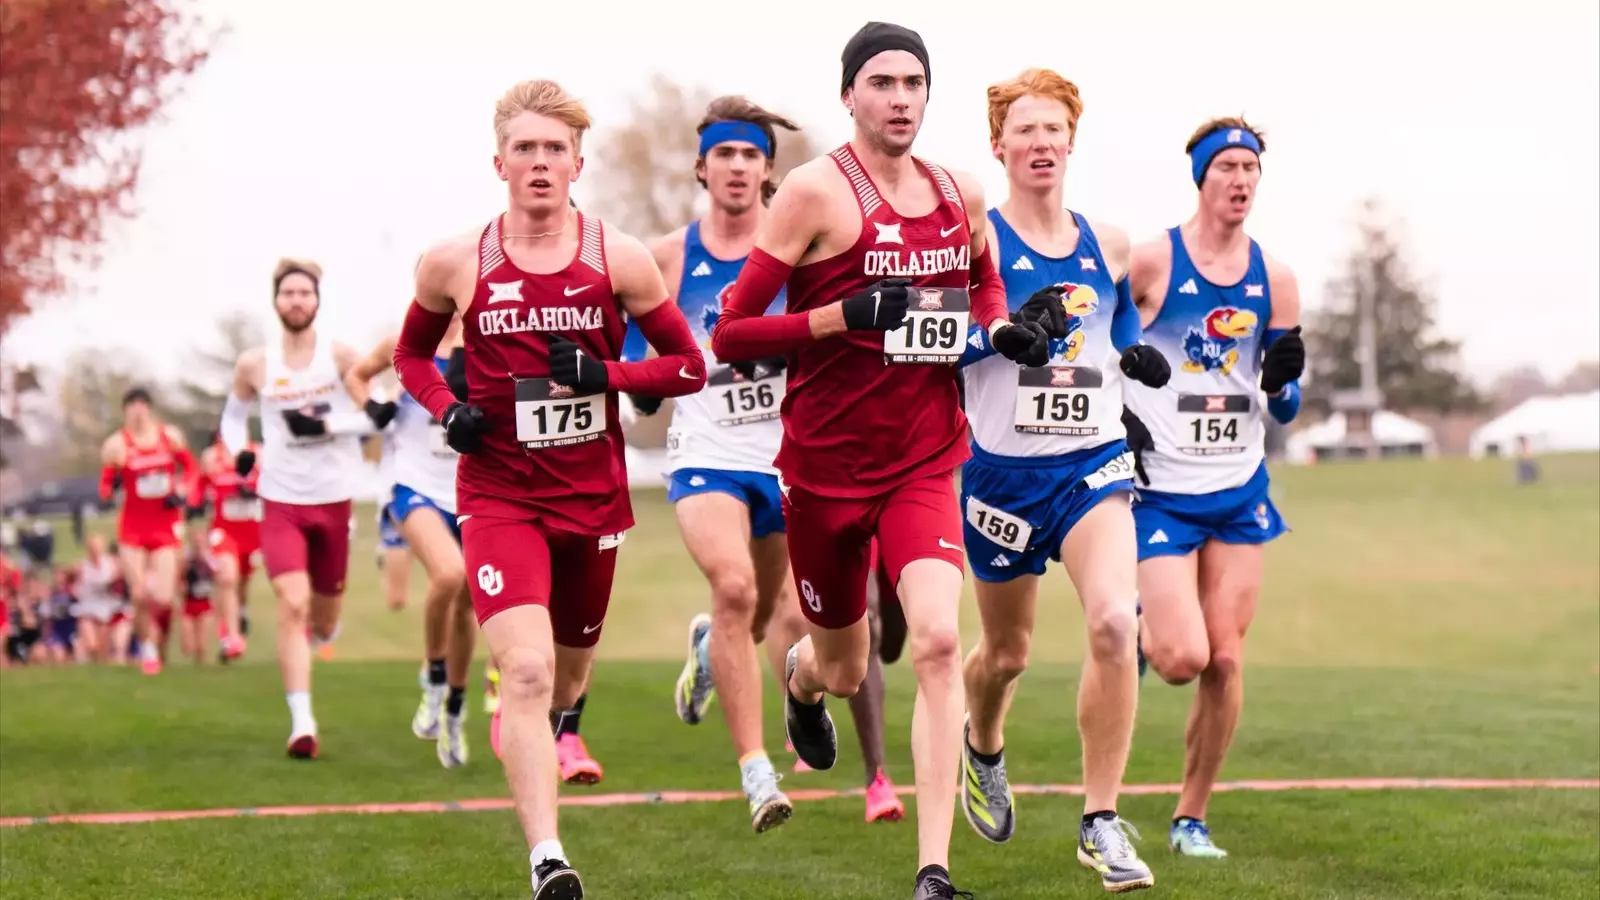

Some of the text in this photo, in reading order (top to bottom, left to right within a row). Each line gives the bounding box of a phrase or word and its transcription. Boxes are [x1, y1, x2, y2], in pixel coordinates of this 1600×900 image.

[478, 306, 604, 336] OKLAHOMA
[902, 317, 958, 349] 169
[722, 383, 775, 414] 156
[1032, 392, 1090, 422] 159
[532, 401, 593, 435] 175
[1190, 418, 1239, 443] 154
[975, 508, 1020, 545] 159
[477, 563, 504, 596] OU
[801, 579, 822, 613] OU
